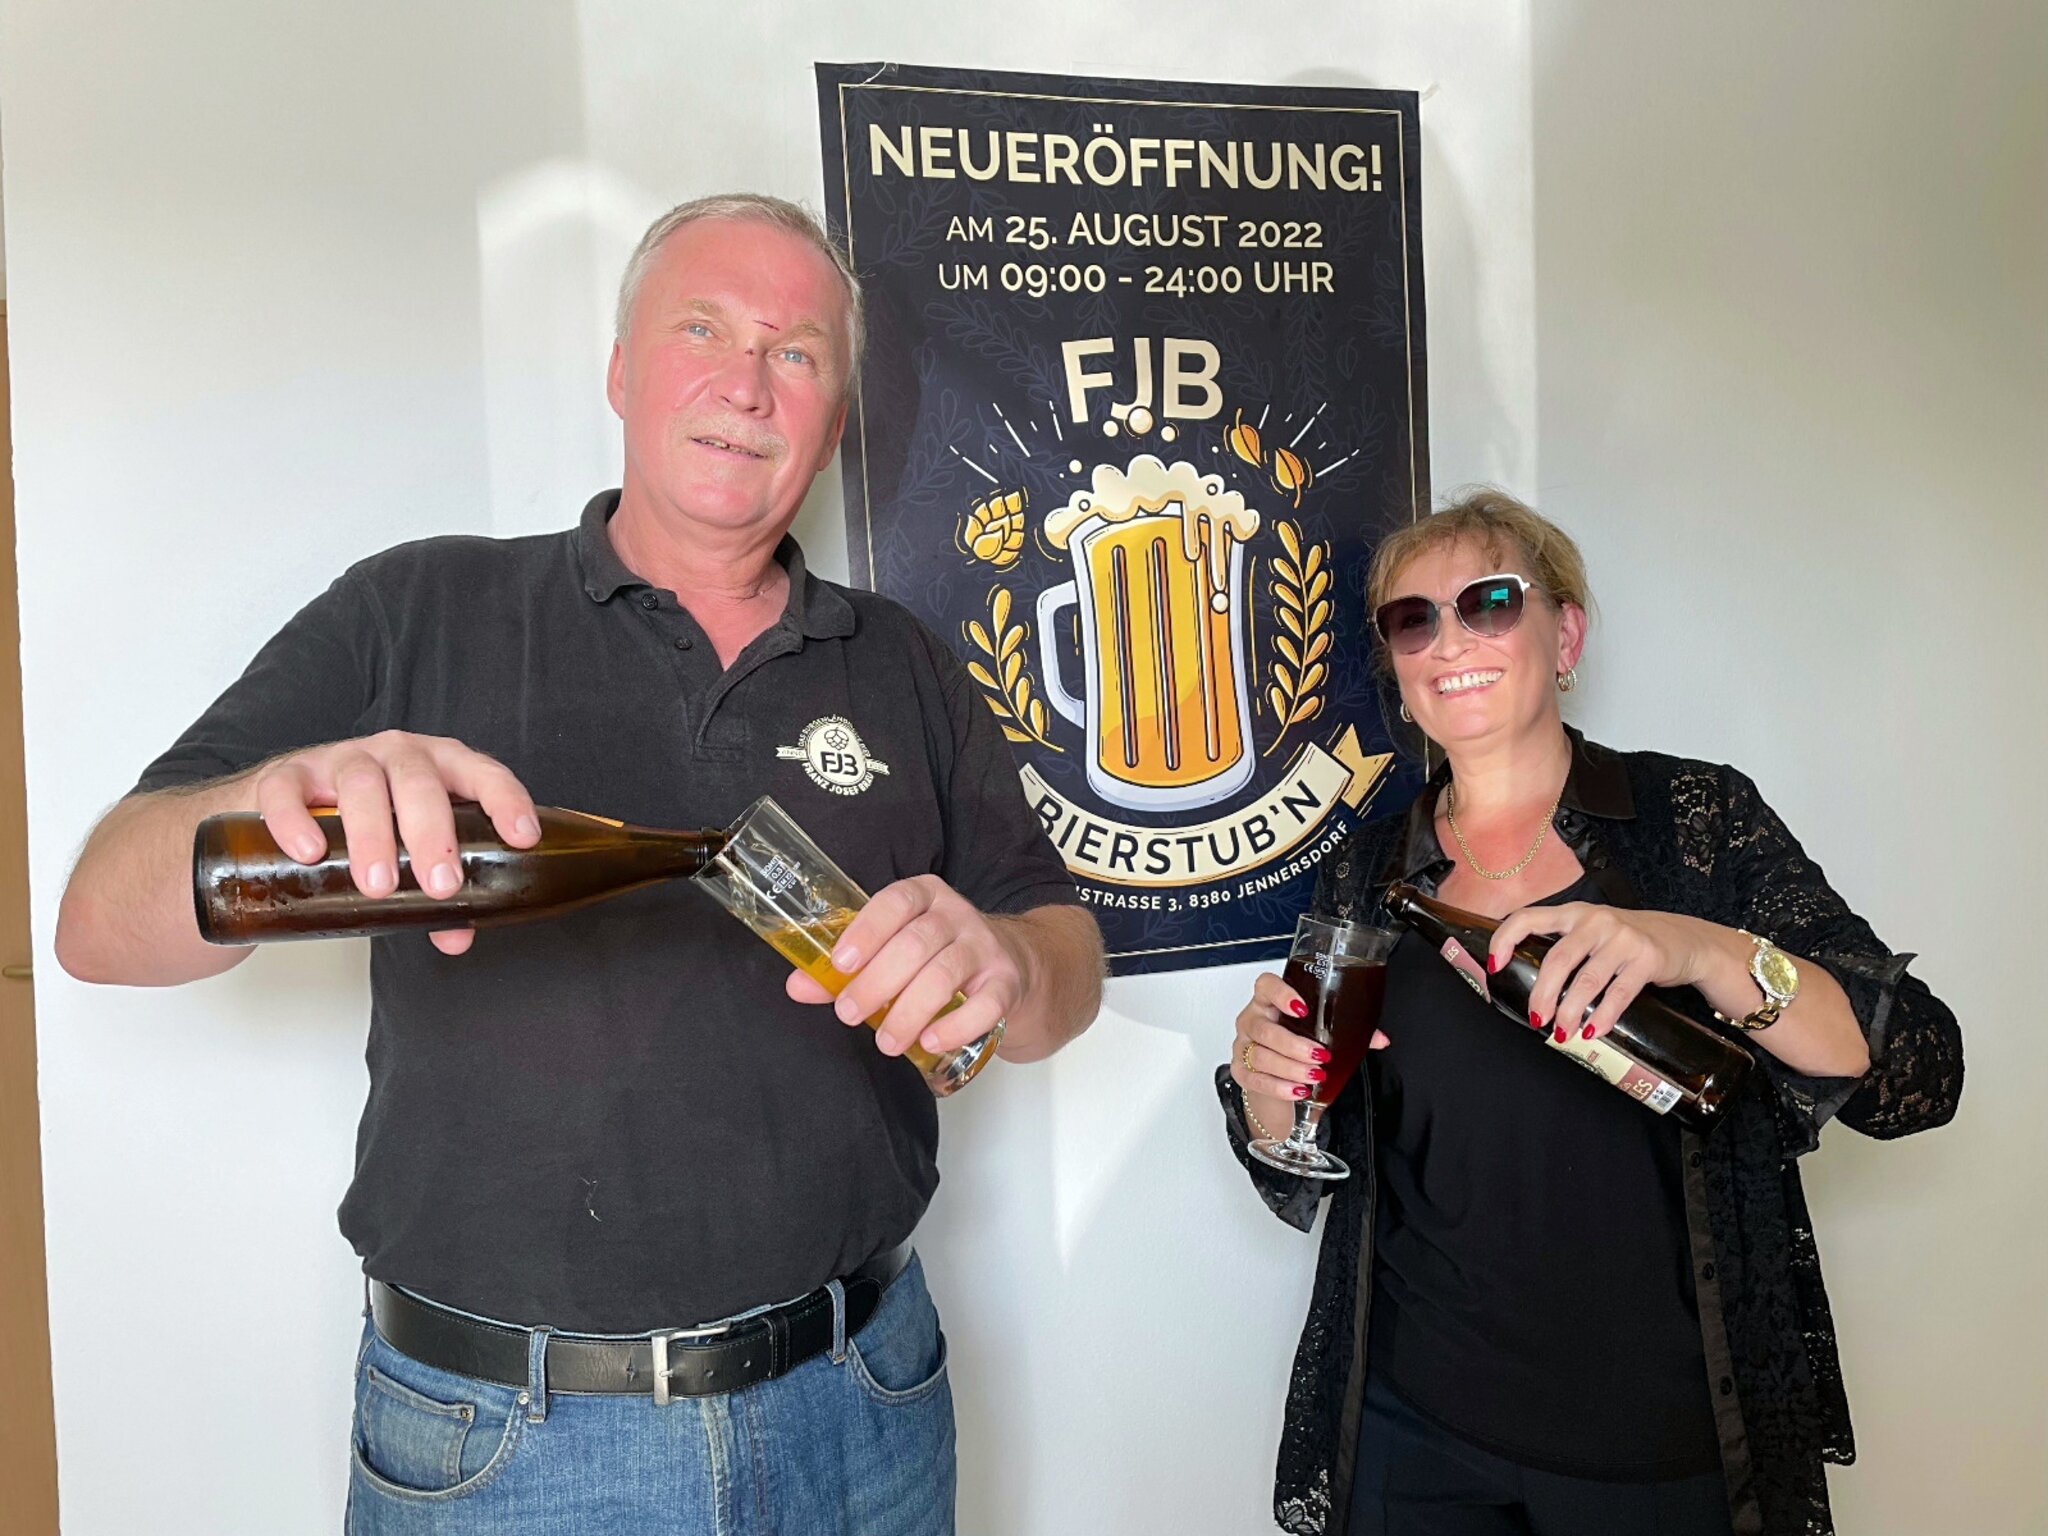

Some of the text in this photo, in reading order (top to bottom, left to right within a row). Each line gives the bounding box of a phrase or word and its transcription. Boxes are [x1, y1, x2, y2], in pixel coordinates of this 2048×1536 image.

[868, 123, 1383, 192] NEUERÖFFNUNG!
[946, 212, 1323, 250] AM 25. AUGUST 2022
[938, 263, 988, 290] UM
[1000, 262, 1106, 298] 09:00
[1144, 265, 1242, 298] 24:00
[1254, 261, 1334, 293] UHR
[1061, 337, 1224, 424] FJB
[802, 762, 831, 790] FRANZ
[829, 784, 859, 796] JOSEF
[820, 751, 859, 776] FJB
[1034, 779, 1323, 875] BIERSTUB'N
[1076, 820, 1349, 912] STRASSE 3, 8380 JENNERSDORF
